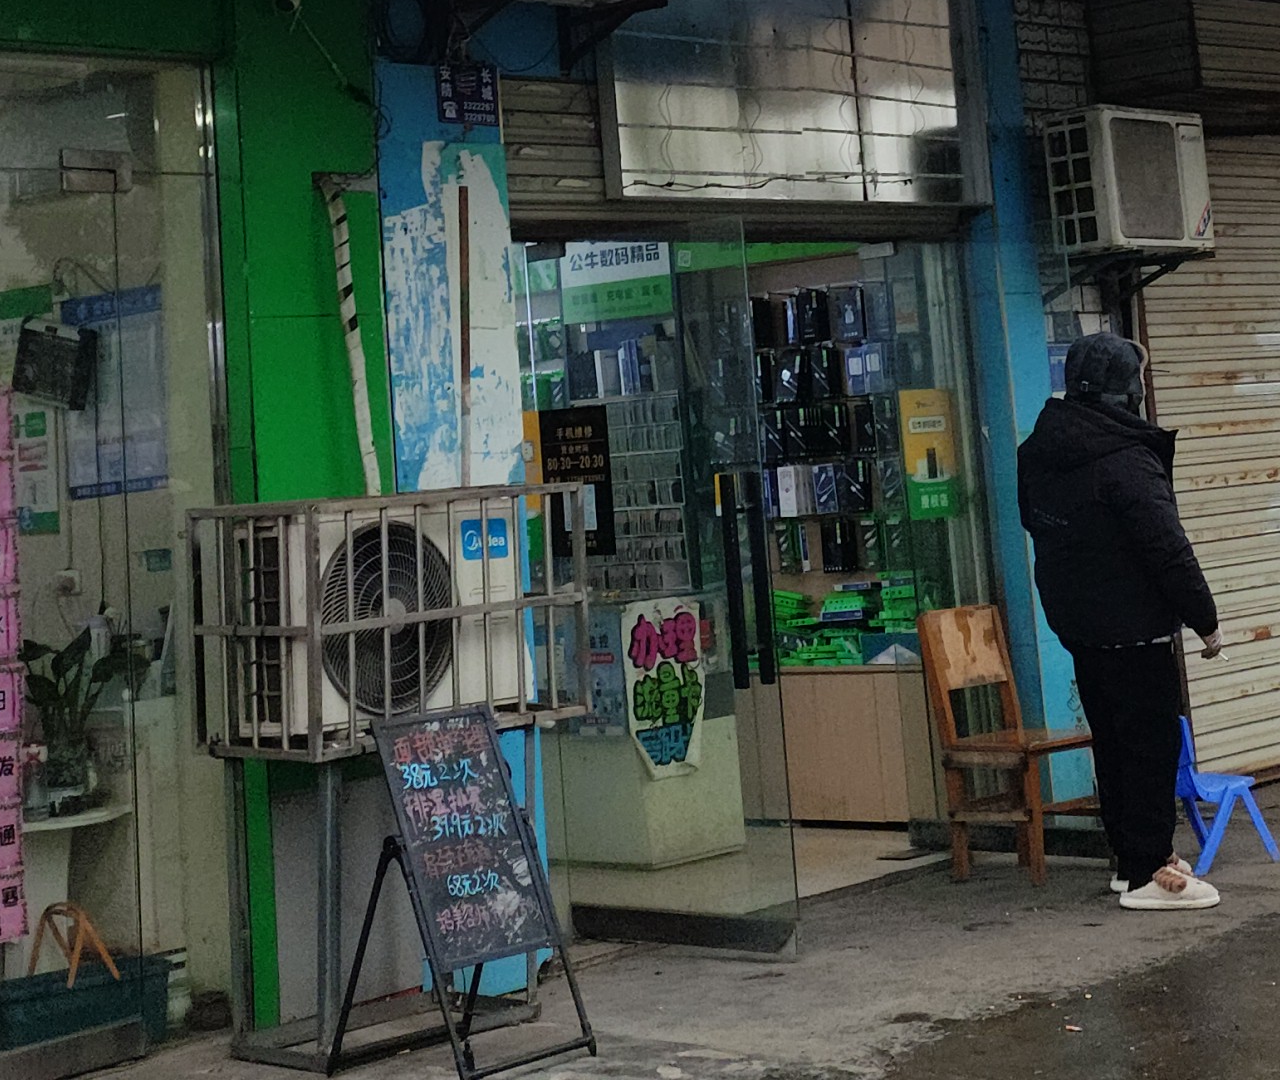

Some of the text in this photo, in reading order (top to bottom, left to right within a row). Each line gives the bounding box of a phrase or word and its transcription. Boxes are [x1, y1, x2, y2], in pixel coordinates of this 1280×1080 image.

[569, 243, 660, 272] 公牛数码精品
[627, 610, 699, 672] 办理
[632, 660, 703, 725] 流量卡
